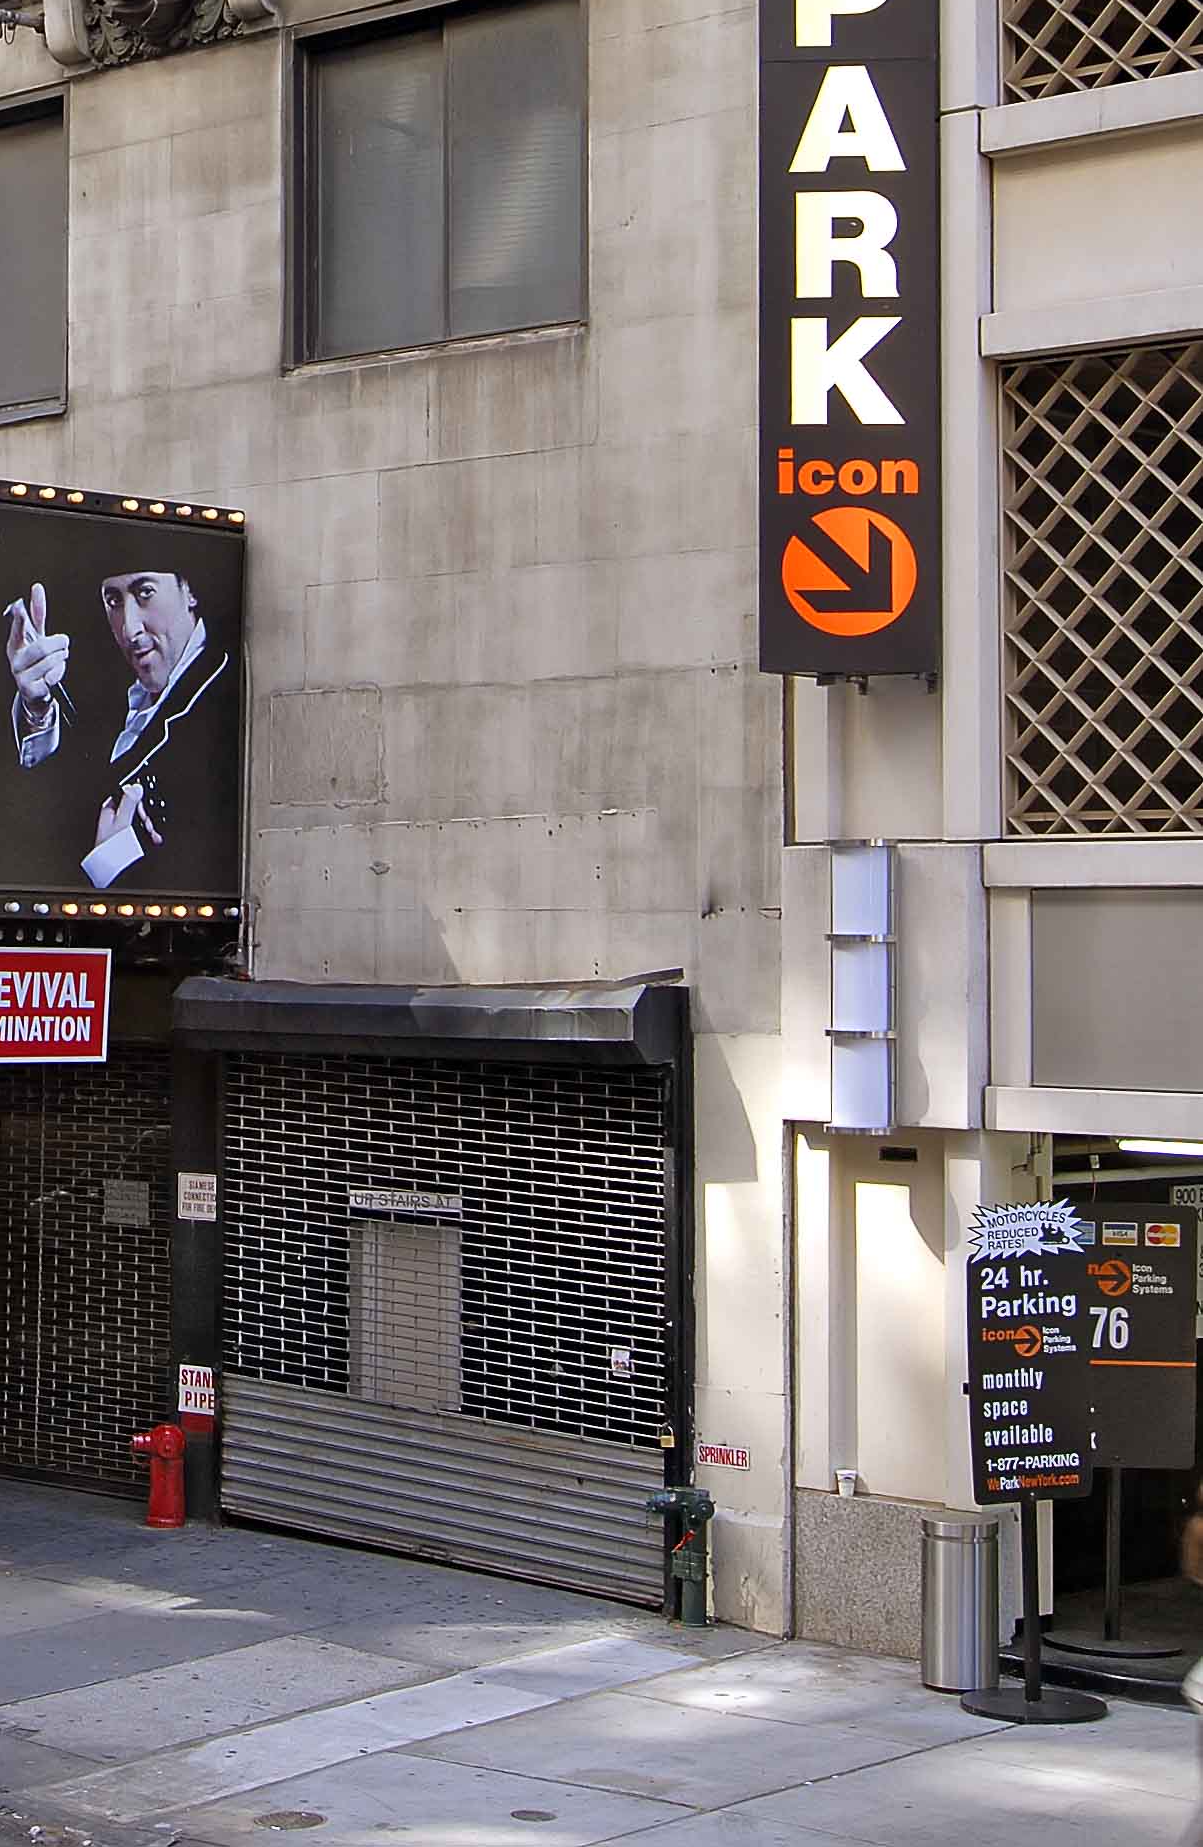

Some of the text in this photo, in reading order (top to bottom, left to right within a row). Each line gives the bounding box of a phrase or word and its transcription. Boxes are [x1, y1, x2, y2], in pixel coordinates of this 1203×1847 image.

[778, 448, 919, 496] icon
[987, 1210, 1067, 1229] MOTORCYCLES
[987, 1227, 1039, 1240] REDUCED
[987, 1238, 1025, 1250] RATES!
[980, 1265, 1048, 1290] 24 hr.
[1132, 1263, 1153, 1273] Icon
[1132, 1273, 1167, 1285] Parking
[1132, 1284, 1174, 1295] Systems
[981, 1292, 1077, 1318] Parking
[982, 1327, 1015, 1341] icon
[1042, 1326, 1060, 1334] Icon
[1089, 1306, 1129, 1350] 76
[181, 1368, 214, 1388] STAN
[982, 1367, 1044, 1390] monthly
[185, 1390, 214, 1409] PIPE
[983, 1400, 1028, 1420] space
[984, 1423, 1053, 1447] available
[699, 1445, 747, 1467] SPRINKLER
[986, 1453, 1080, 1472] 1-877-PARKING
